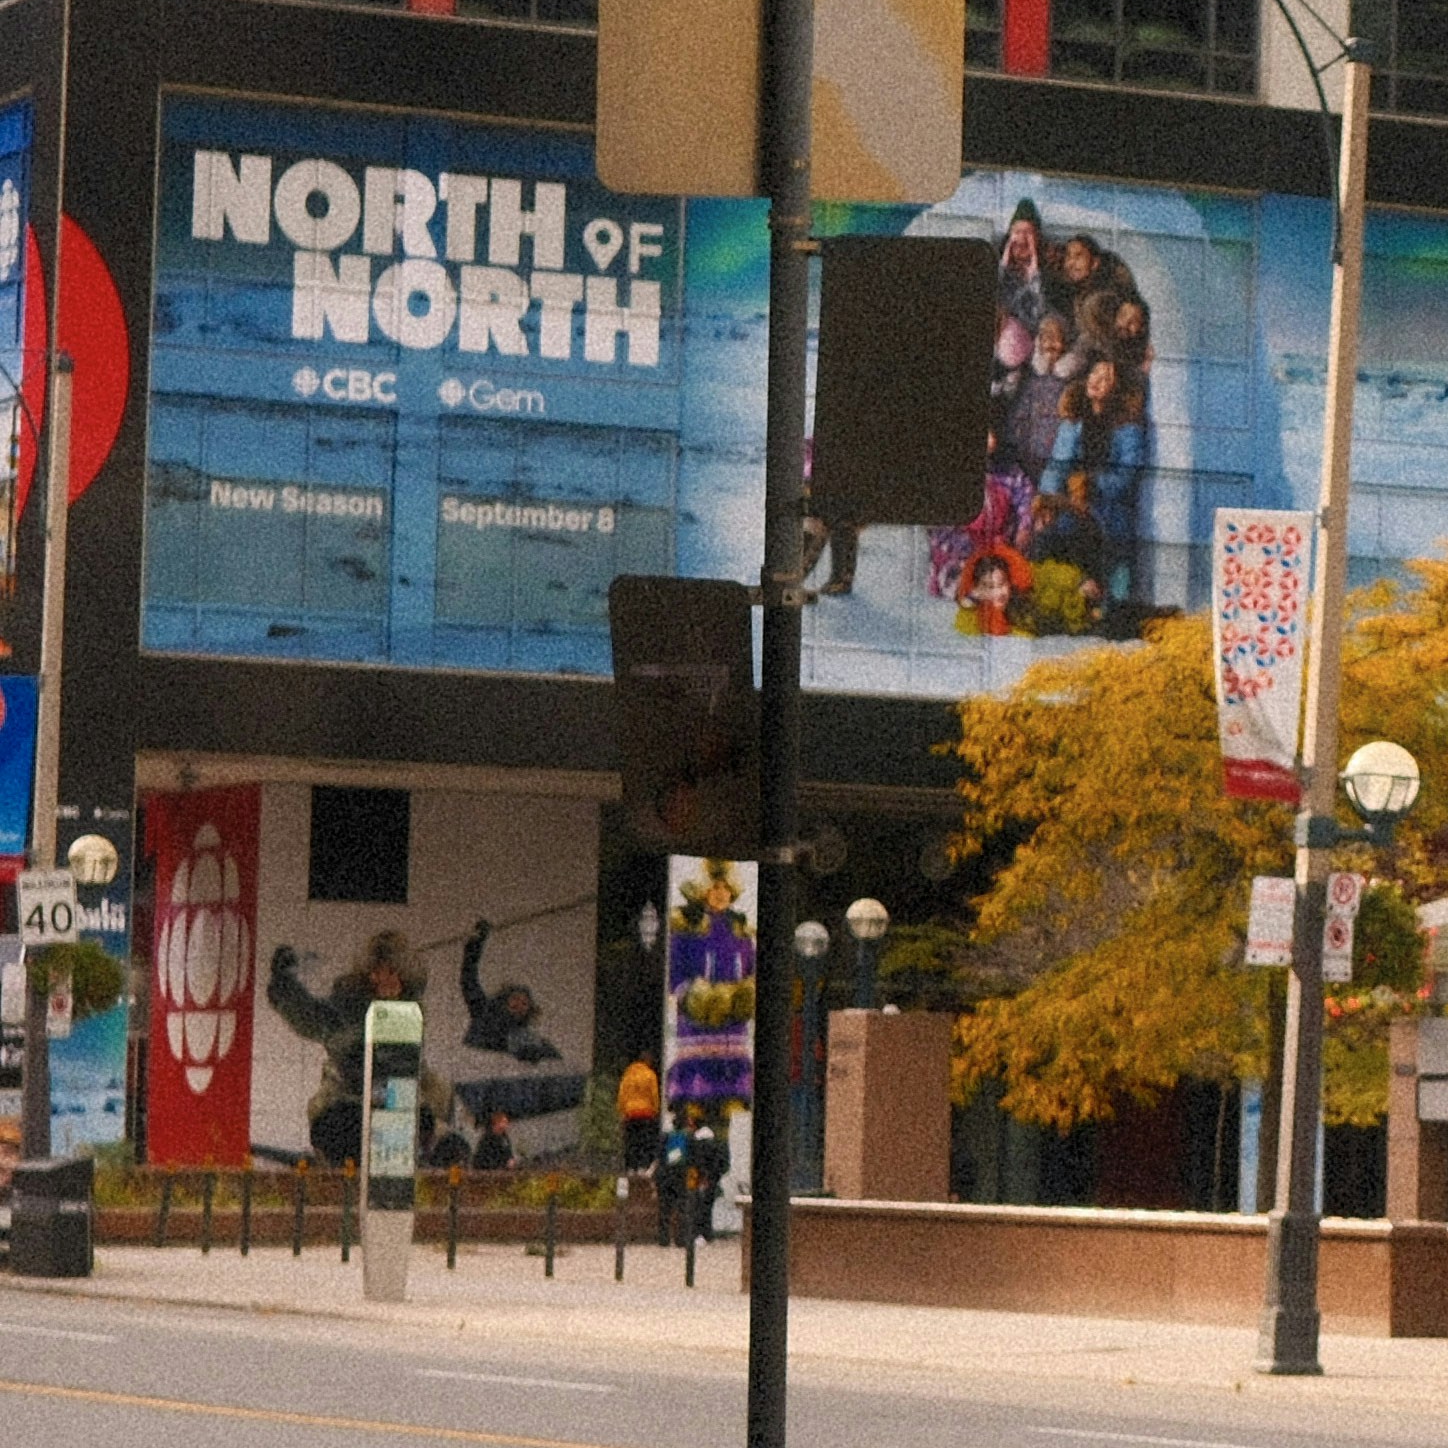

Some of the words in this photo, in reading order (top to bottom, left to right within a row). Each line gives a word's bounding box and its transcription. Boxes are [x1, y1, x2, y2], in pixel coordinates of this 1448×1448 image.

[192, 150, 566, 268] NORTH
[583, 218, 664, 274] OF
[292, 251, 662, 367] NORTH
[323, 368, 397, 403] CBC
[469, 380, 545, 414] Gem
[211, 480, 275, 509] New
[282, 486, 384, 518] Season
[443, 497, 593, 531] September
[599, 507, 616, 533] 8
[26, 902, 73, 934] 40
